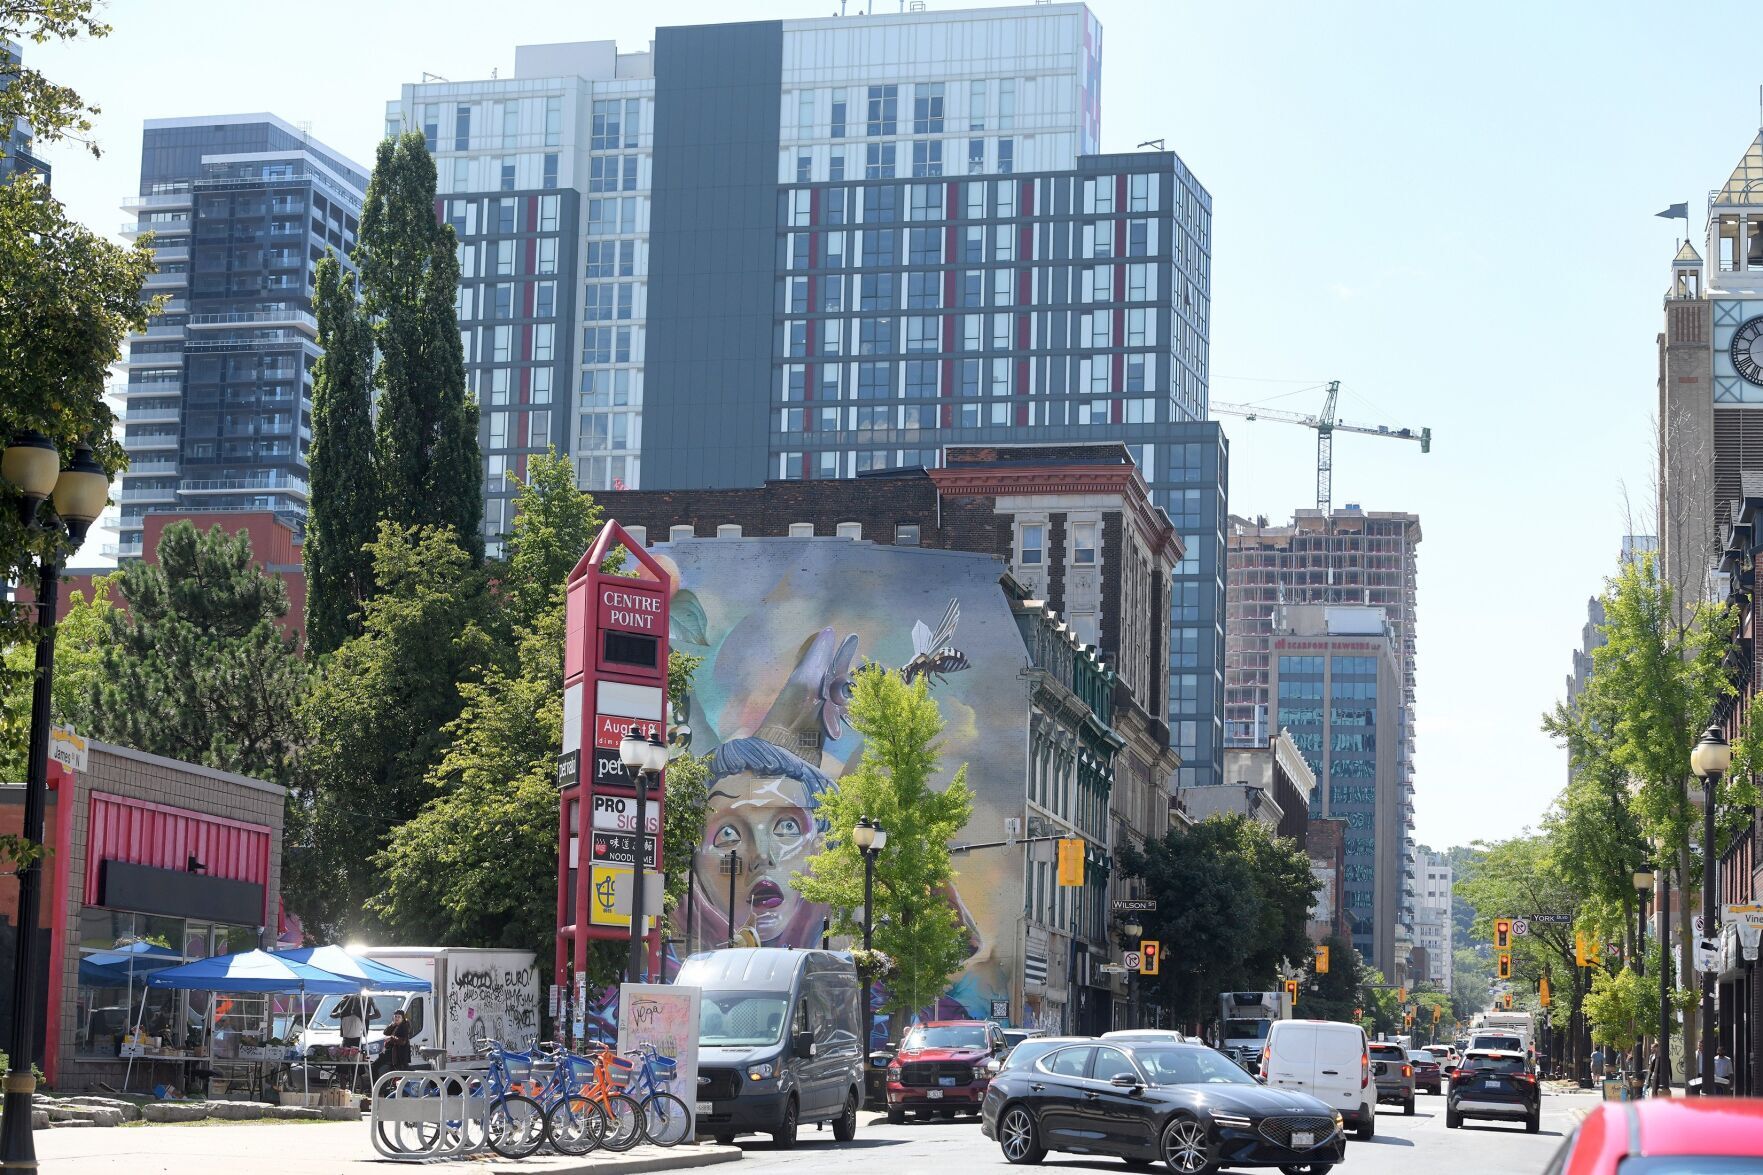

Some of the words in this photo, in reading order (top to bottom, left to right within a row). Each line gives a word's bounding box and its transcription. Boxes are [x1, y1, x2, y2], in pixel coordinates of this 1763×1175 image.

[604, 591, 661, 613] CENTRE
[610, 610, 654, 629] POINT
[603, 719, 647, 738] Augt
[598, 736, 613, 746] dim
[597, 758, 624, 778] pet
[594, 797, 626, 814] PRO
[609, 852, 637, 863] NOODL
[1113, 901, 1146, 909] WILSON
[1533, 914, 1555, 922] YORK
